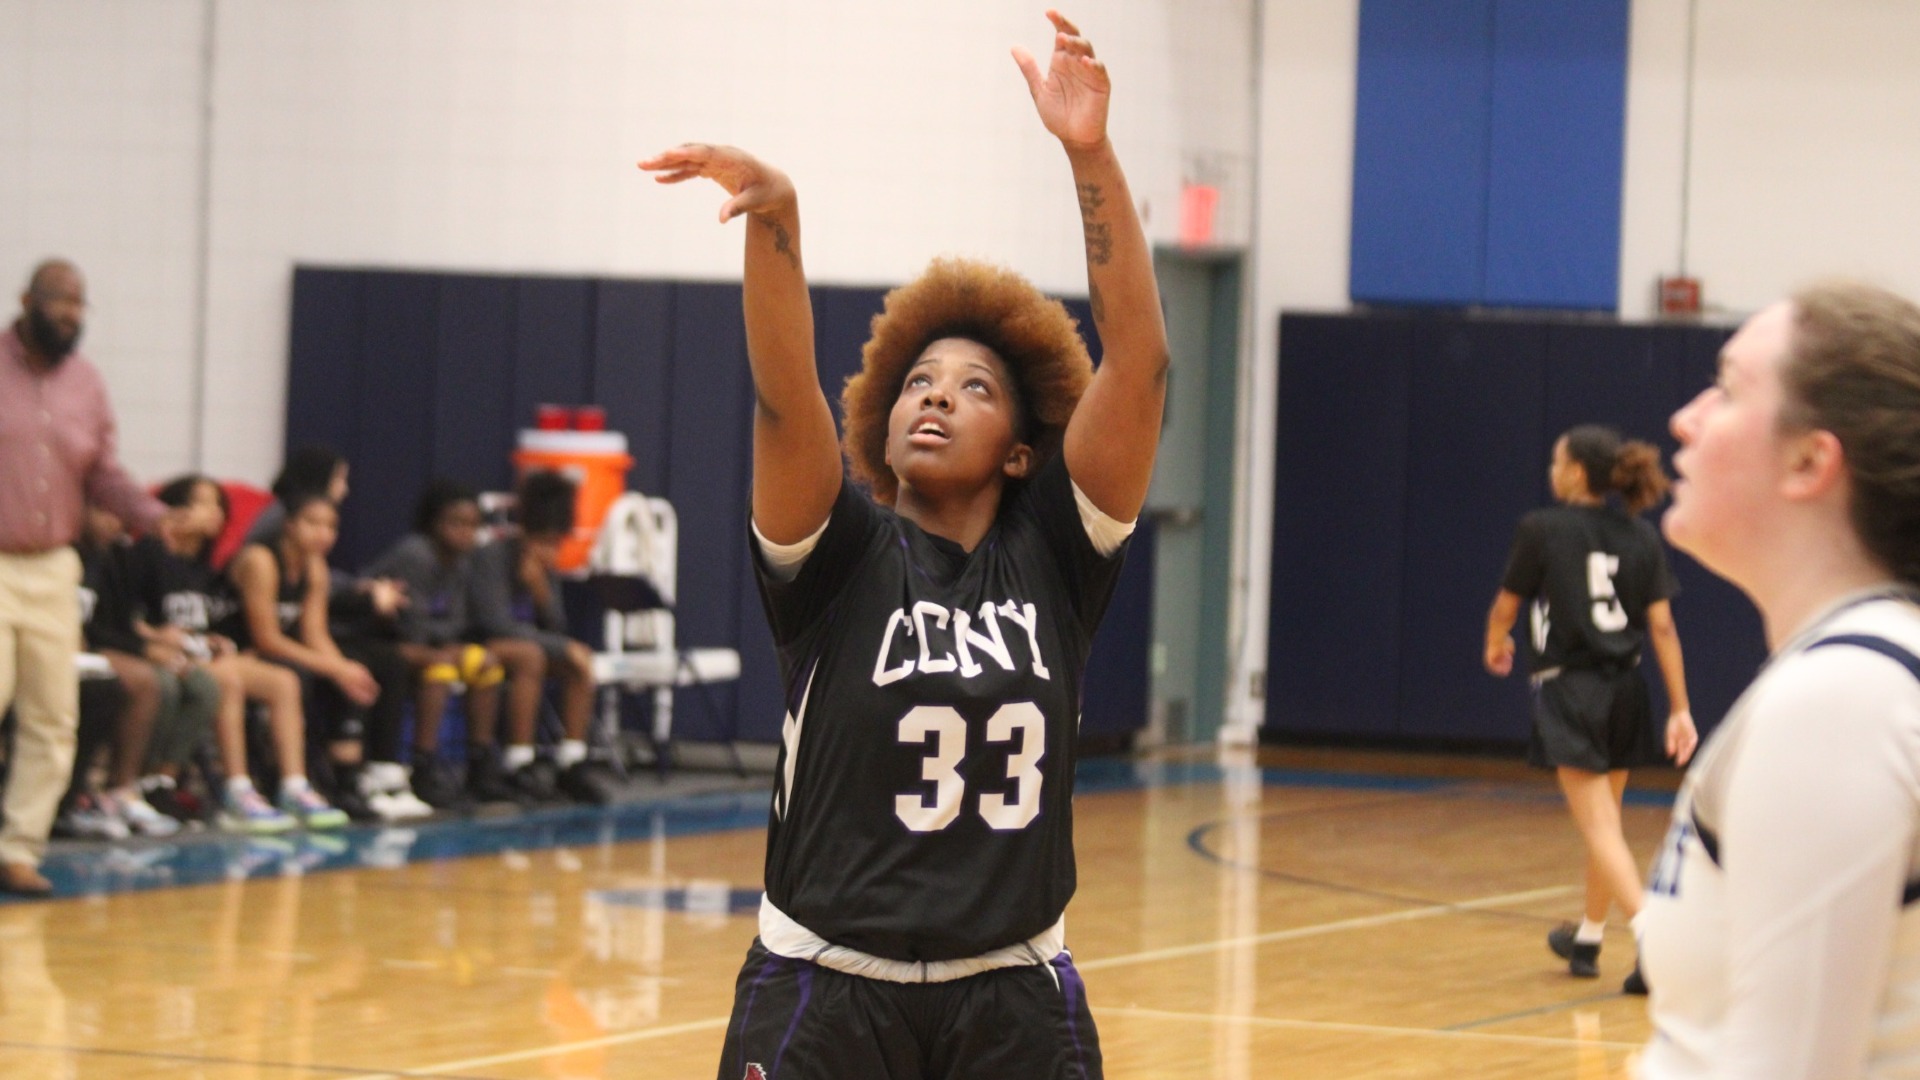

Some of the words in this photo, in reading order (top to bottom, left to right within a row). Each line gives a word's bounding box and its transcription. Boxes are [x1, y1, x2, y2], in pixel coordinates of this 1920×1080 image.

[1586, 551, 1628, 633] 5
[871, 598, 1050, 687] CCNY
[894, 701, 1046, 832] 33
